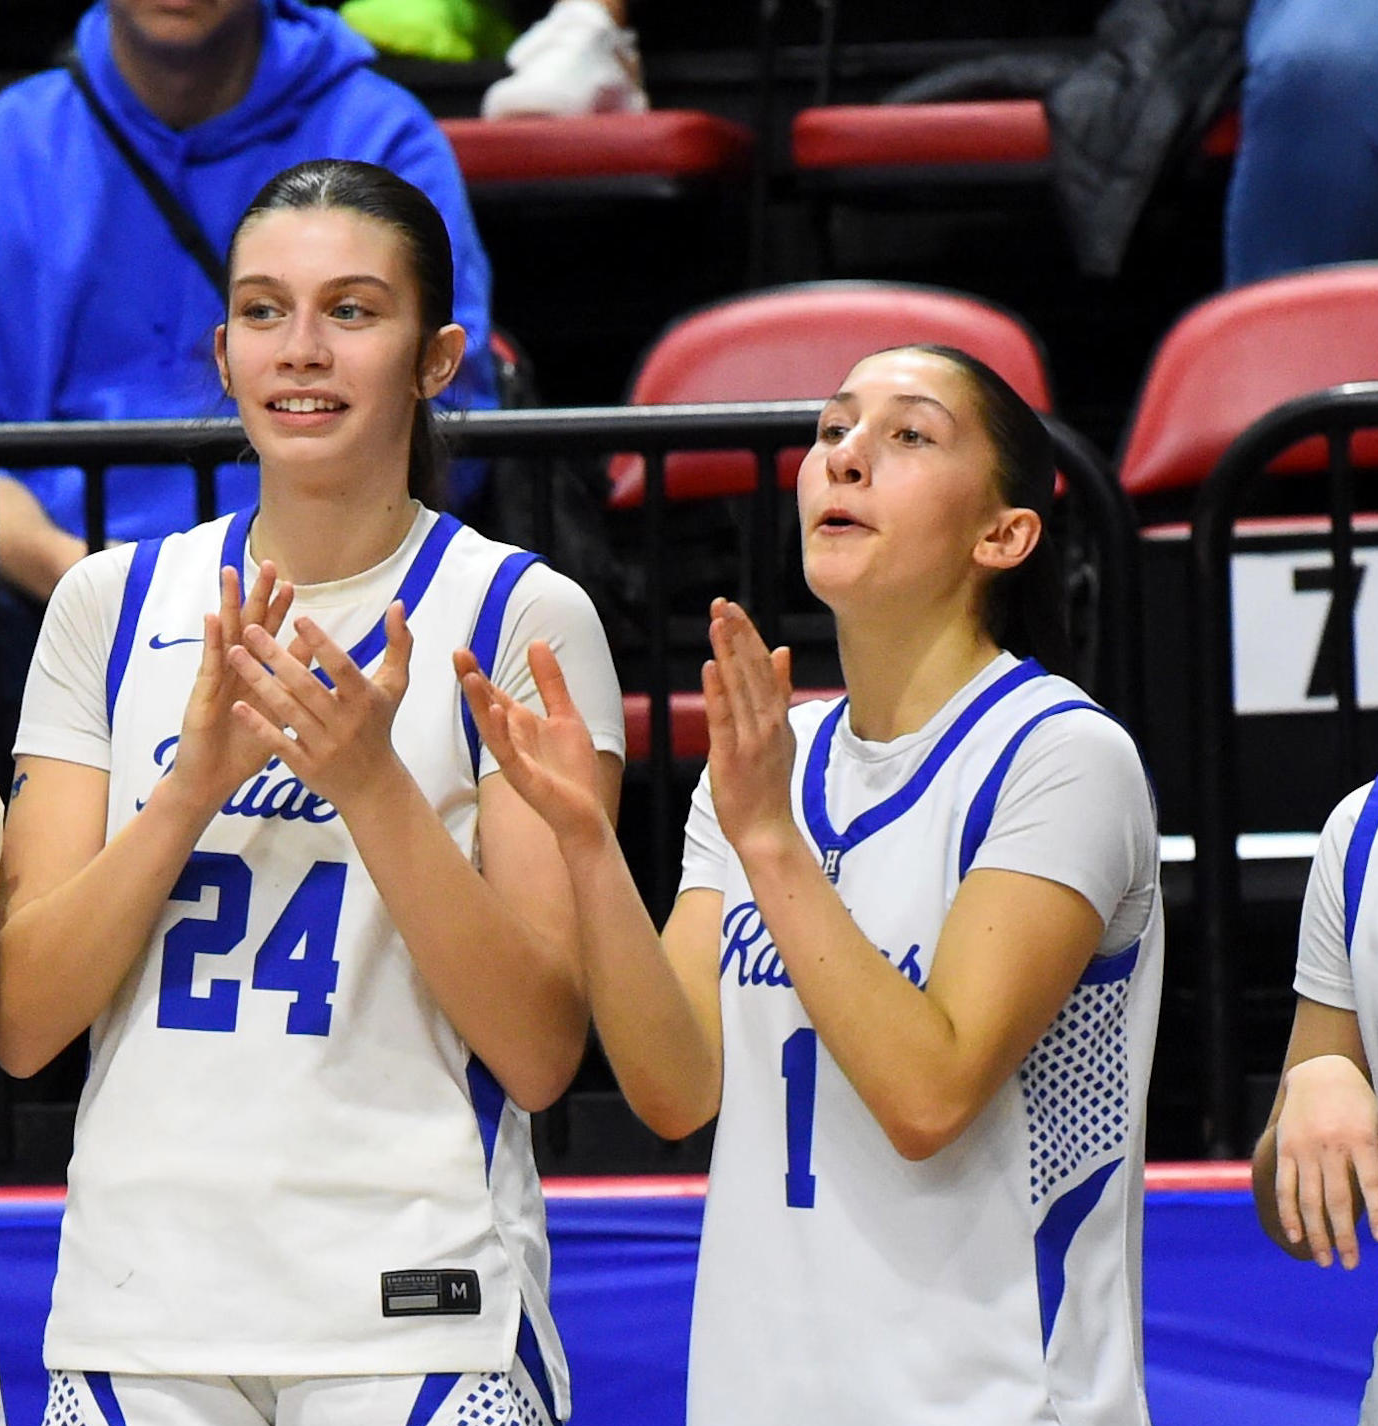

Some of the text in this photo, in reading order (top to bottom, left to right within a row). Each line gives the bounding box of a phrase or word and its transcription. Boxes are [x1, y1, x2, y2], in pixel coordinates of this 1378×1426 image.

[1293, 564, 1367, 698] 7
[157, 851, 348, 1036] 24
[782, 1028, 818, 1209] 1
[451, 1281, 467, 1300] M
